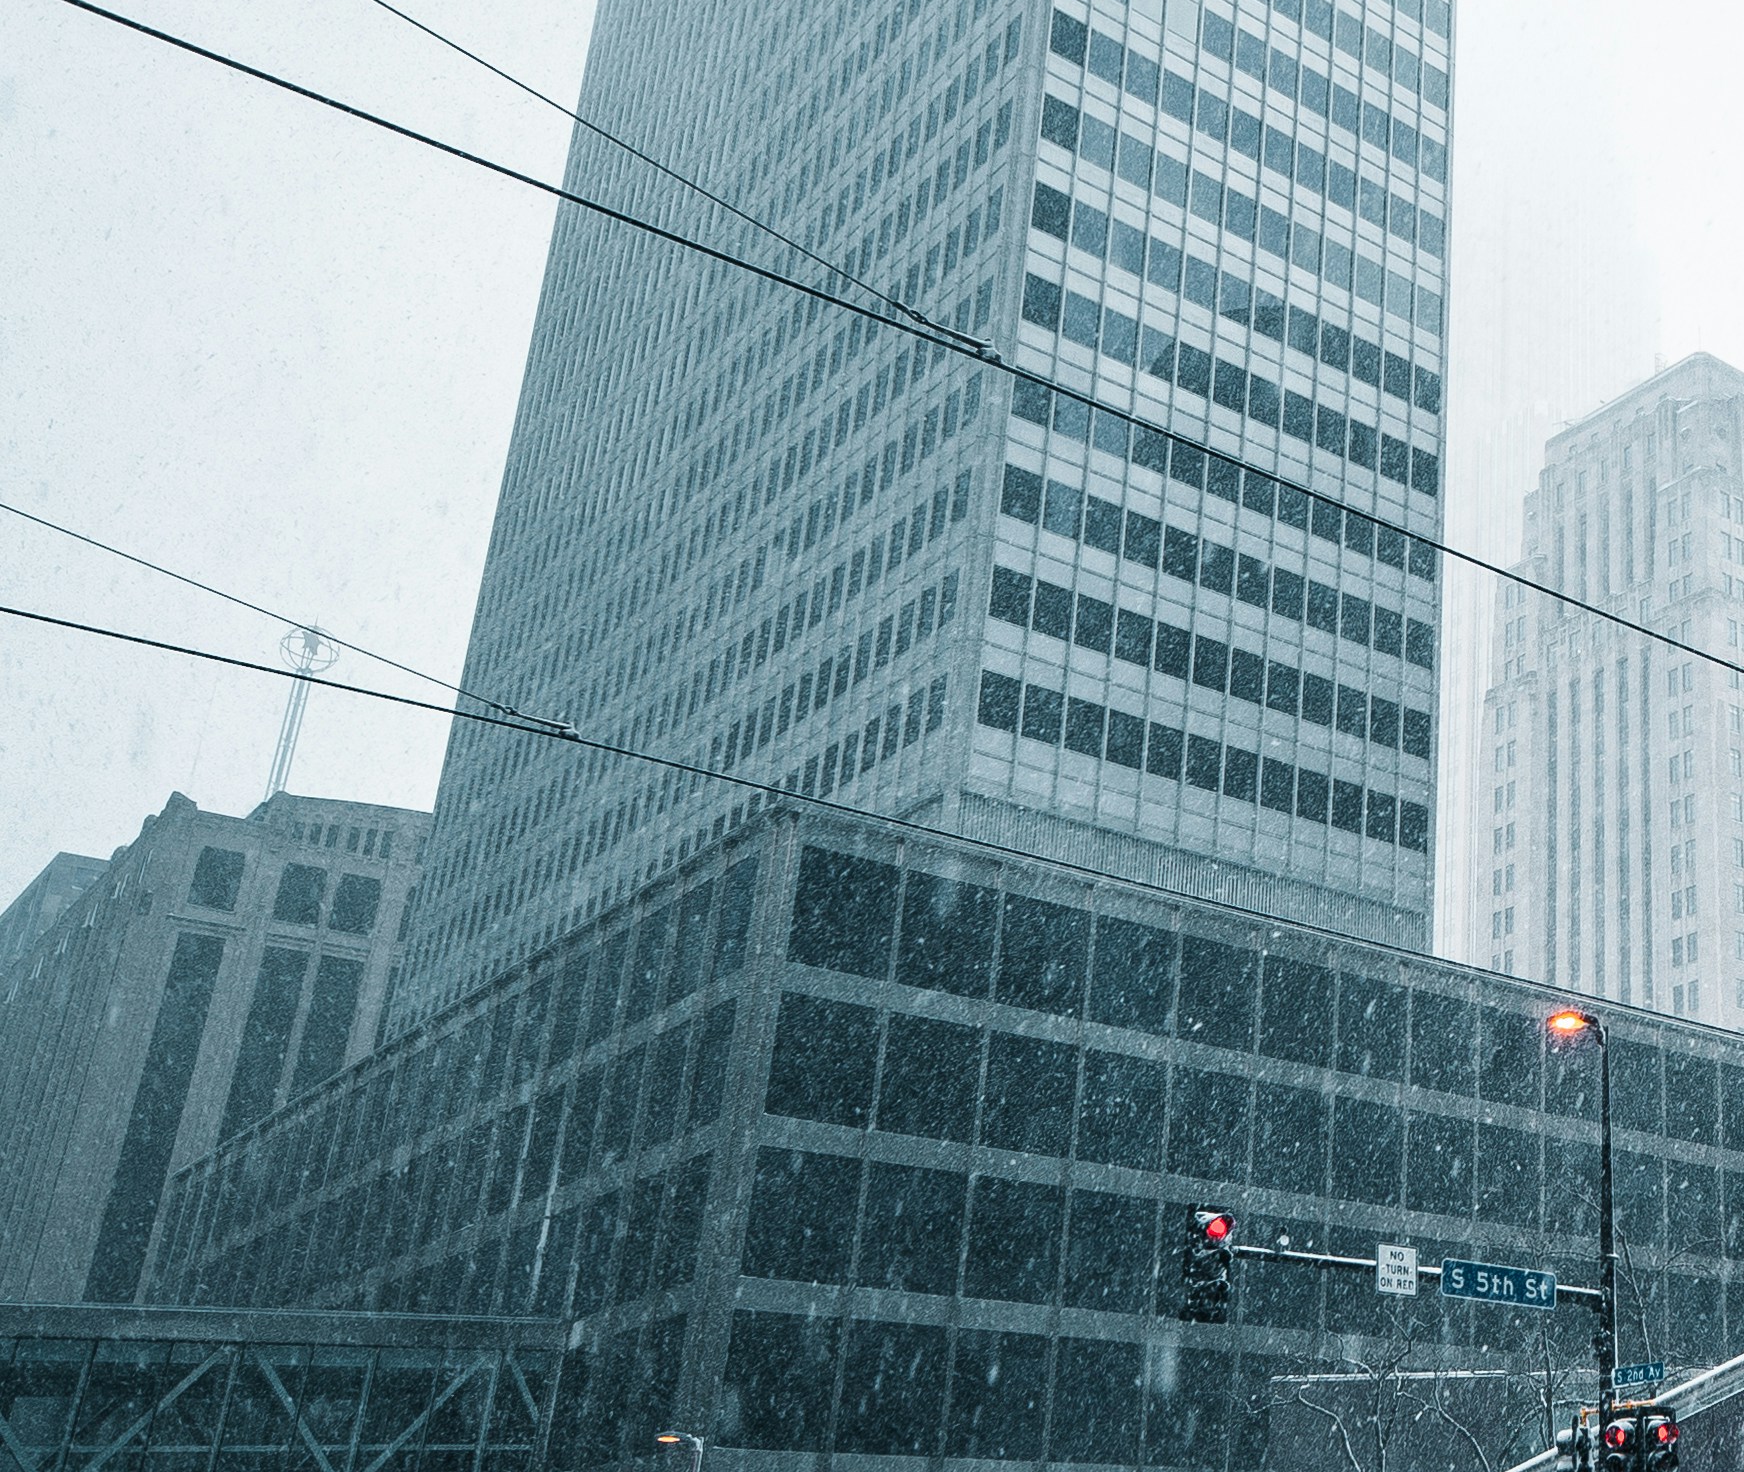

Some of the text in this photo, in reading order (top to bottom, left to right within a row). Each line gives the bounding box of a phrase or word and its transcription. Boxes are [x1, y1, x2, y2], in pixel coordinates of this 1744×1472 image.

[1389, 1250, 1405, 1263] NO
[1385, 1263, 1410, 1277] TURN
[1380, 1279, 1414, 1291] ON RED
[1451, 1268, 1549, 1301] S 5th St
[1617, 1366, 1661, 1384] S 2nd Av
